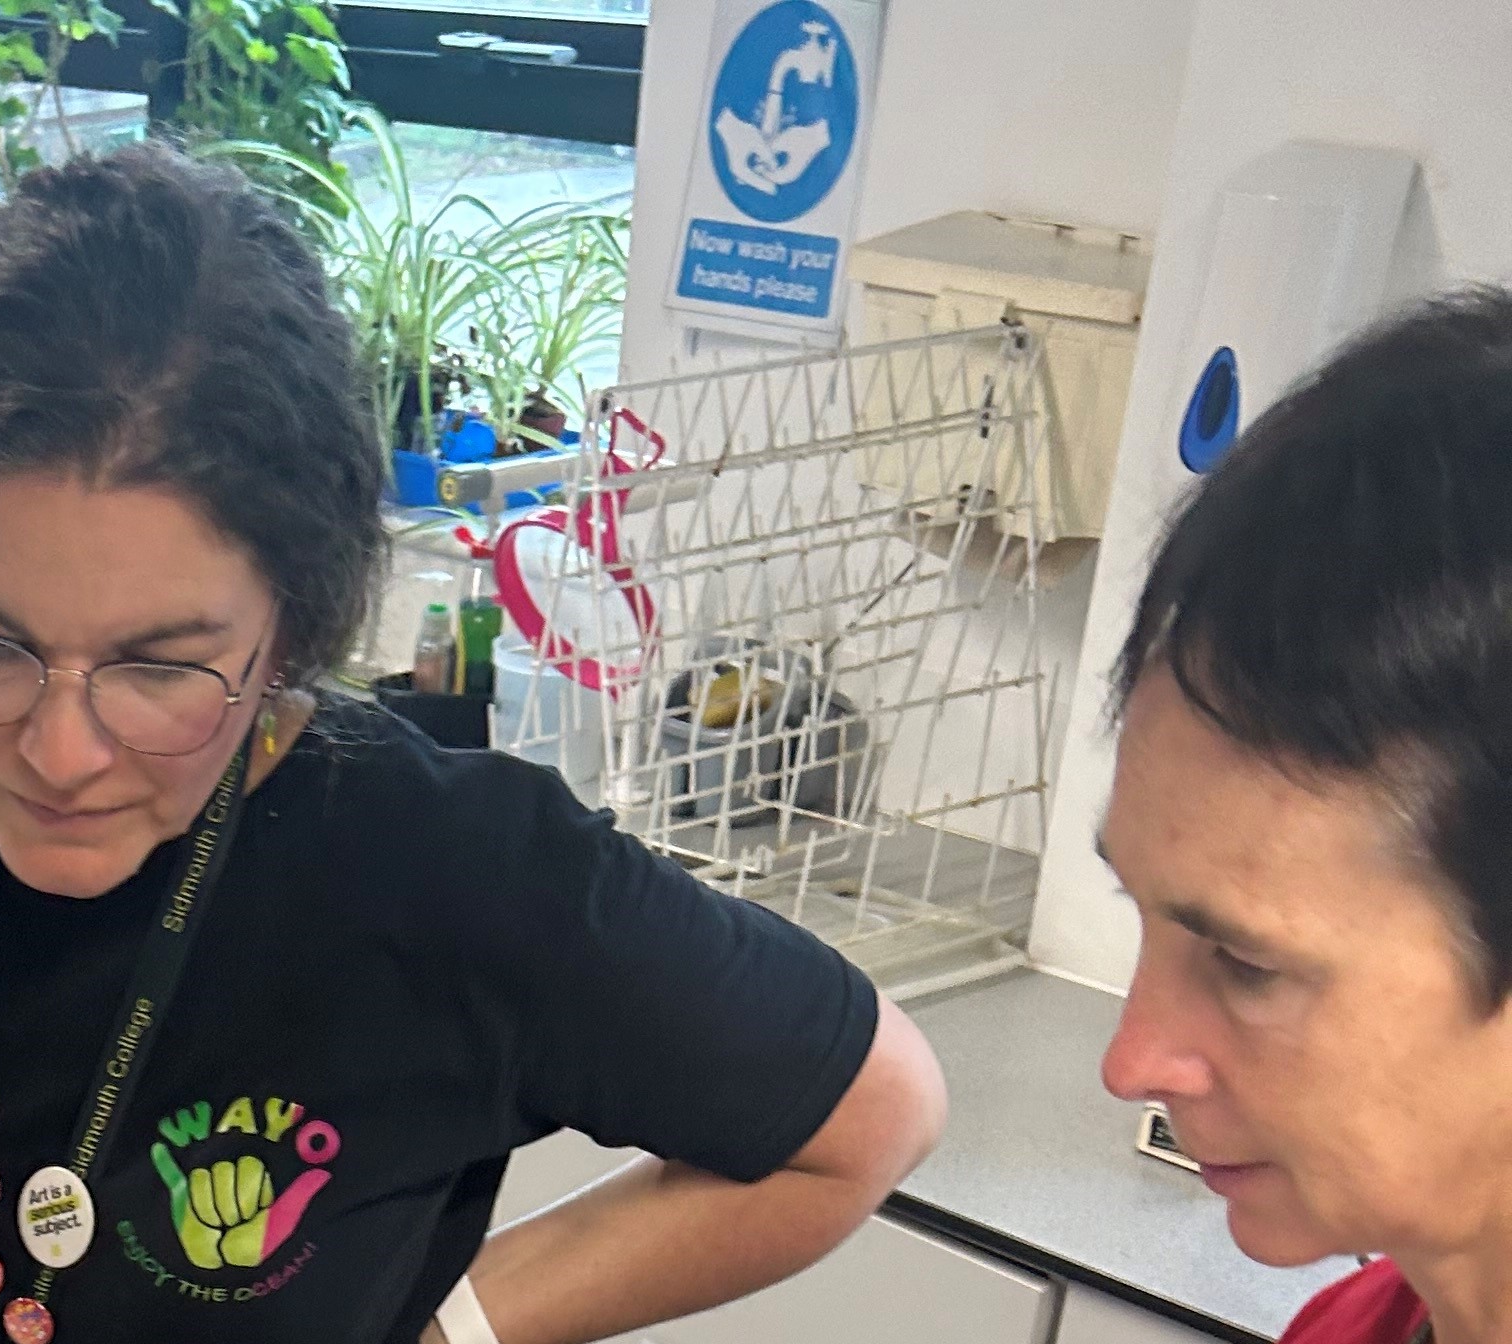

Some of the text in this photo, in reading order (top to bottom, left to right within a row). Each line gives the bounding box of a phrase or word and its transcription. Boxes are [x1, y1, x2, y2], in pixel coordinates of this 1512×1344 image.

[690, 228, 834, 270] Now wash your
[692, 263, 818, 303] hands please
[161, 829, 218, 934] Sidmouth
[106, 998, 154, 1079] College
[157, 1097, 341, 1165] WAYO
[29, 1188, 49, 1205] Art
[51, 1185, 62, 1199] is
[179, 1279, 229, 1302] THE
